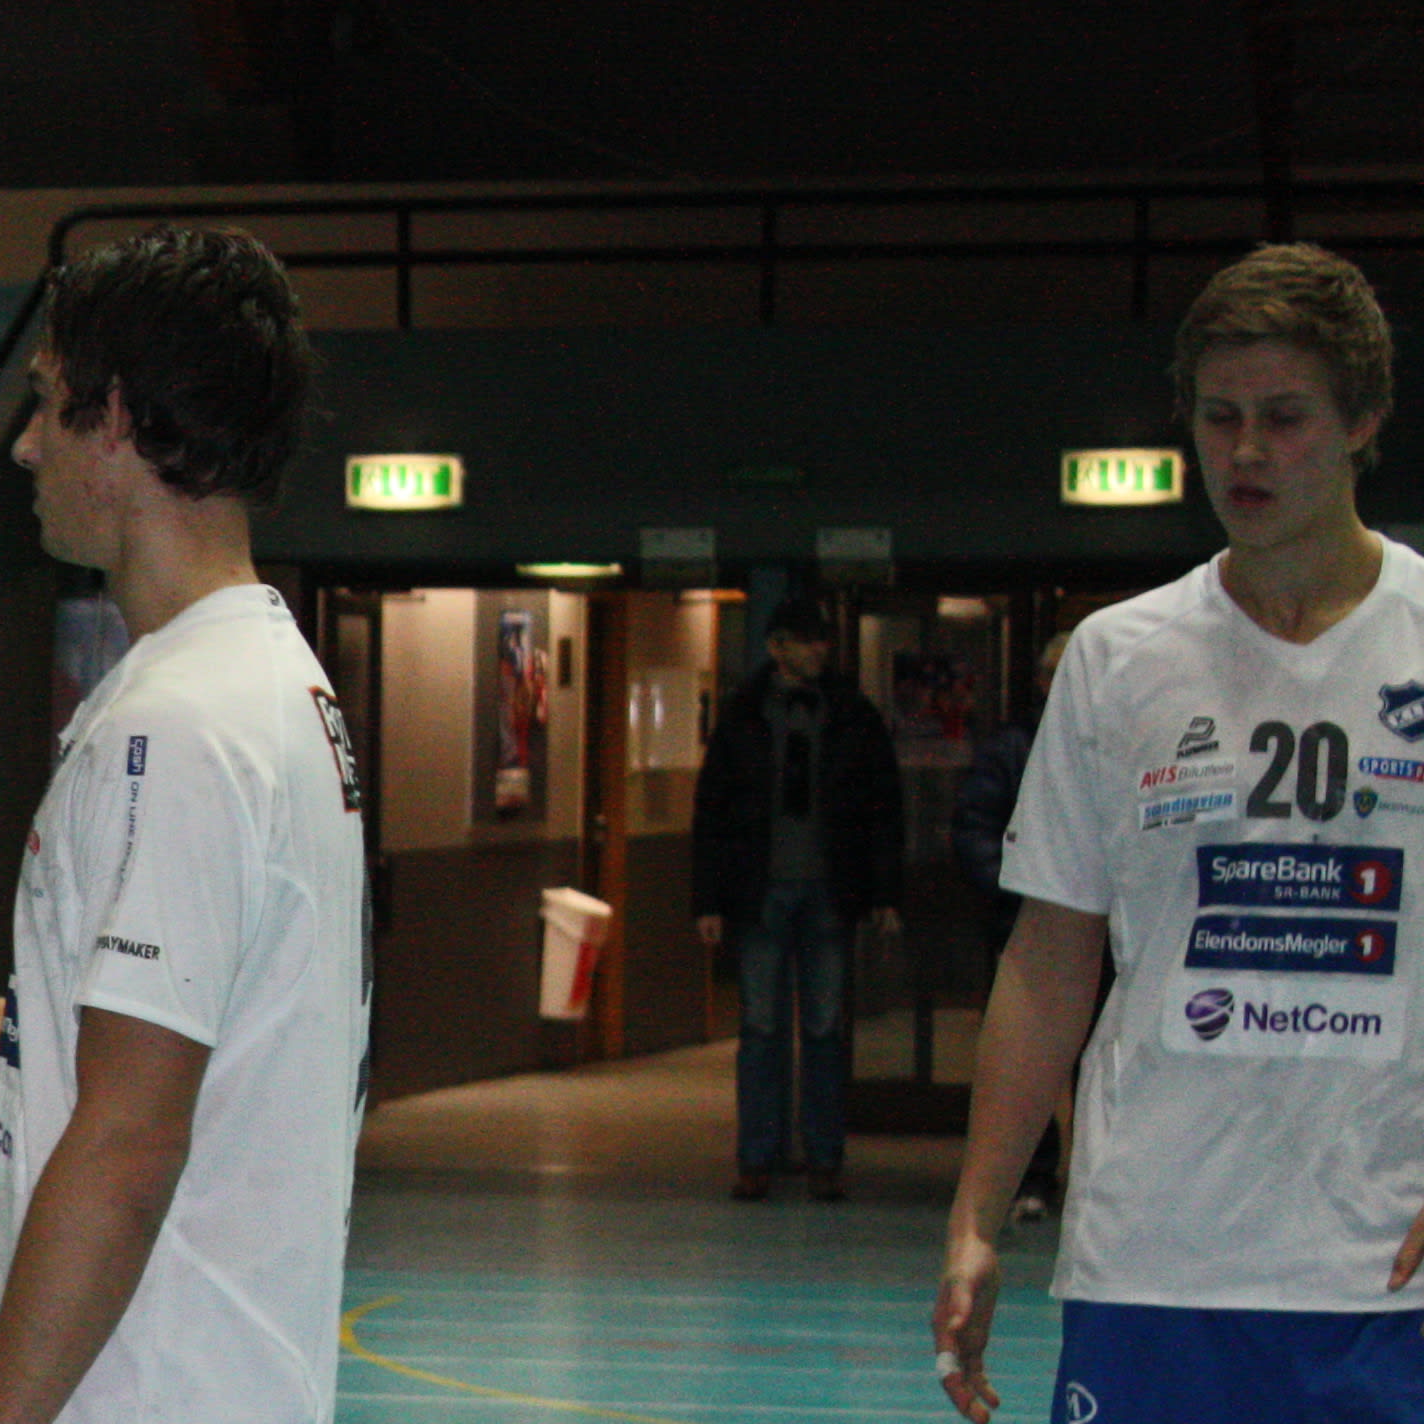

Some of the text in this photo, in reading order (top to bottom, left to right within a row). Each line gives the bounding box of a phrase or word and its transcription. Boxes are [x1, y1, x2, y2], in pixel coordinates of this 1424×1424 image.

[1140, 765, 1178, 789] AVIS
[1246, 720, 1349, 822] 20
[1362, 757, 1412, 777] SPORTS
[1212, 856, 1376, 896] SpareBank 1
[1194, 930, 1373, 959] EiendomsMegler 1
[1242, 1001, 1382, 1036] NetCom
